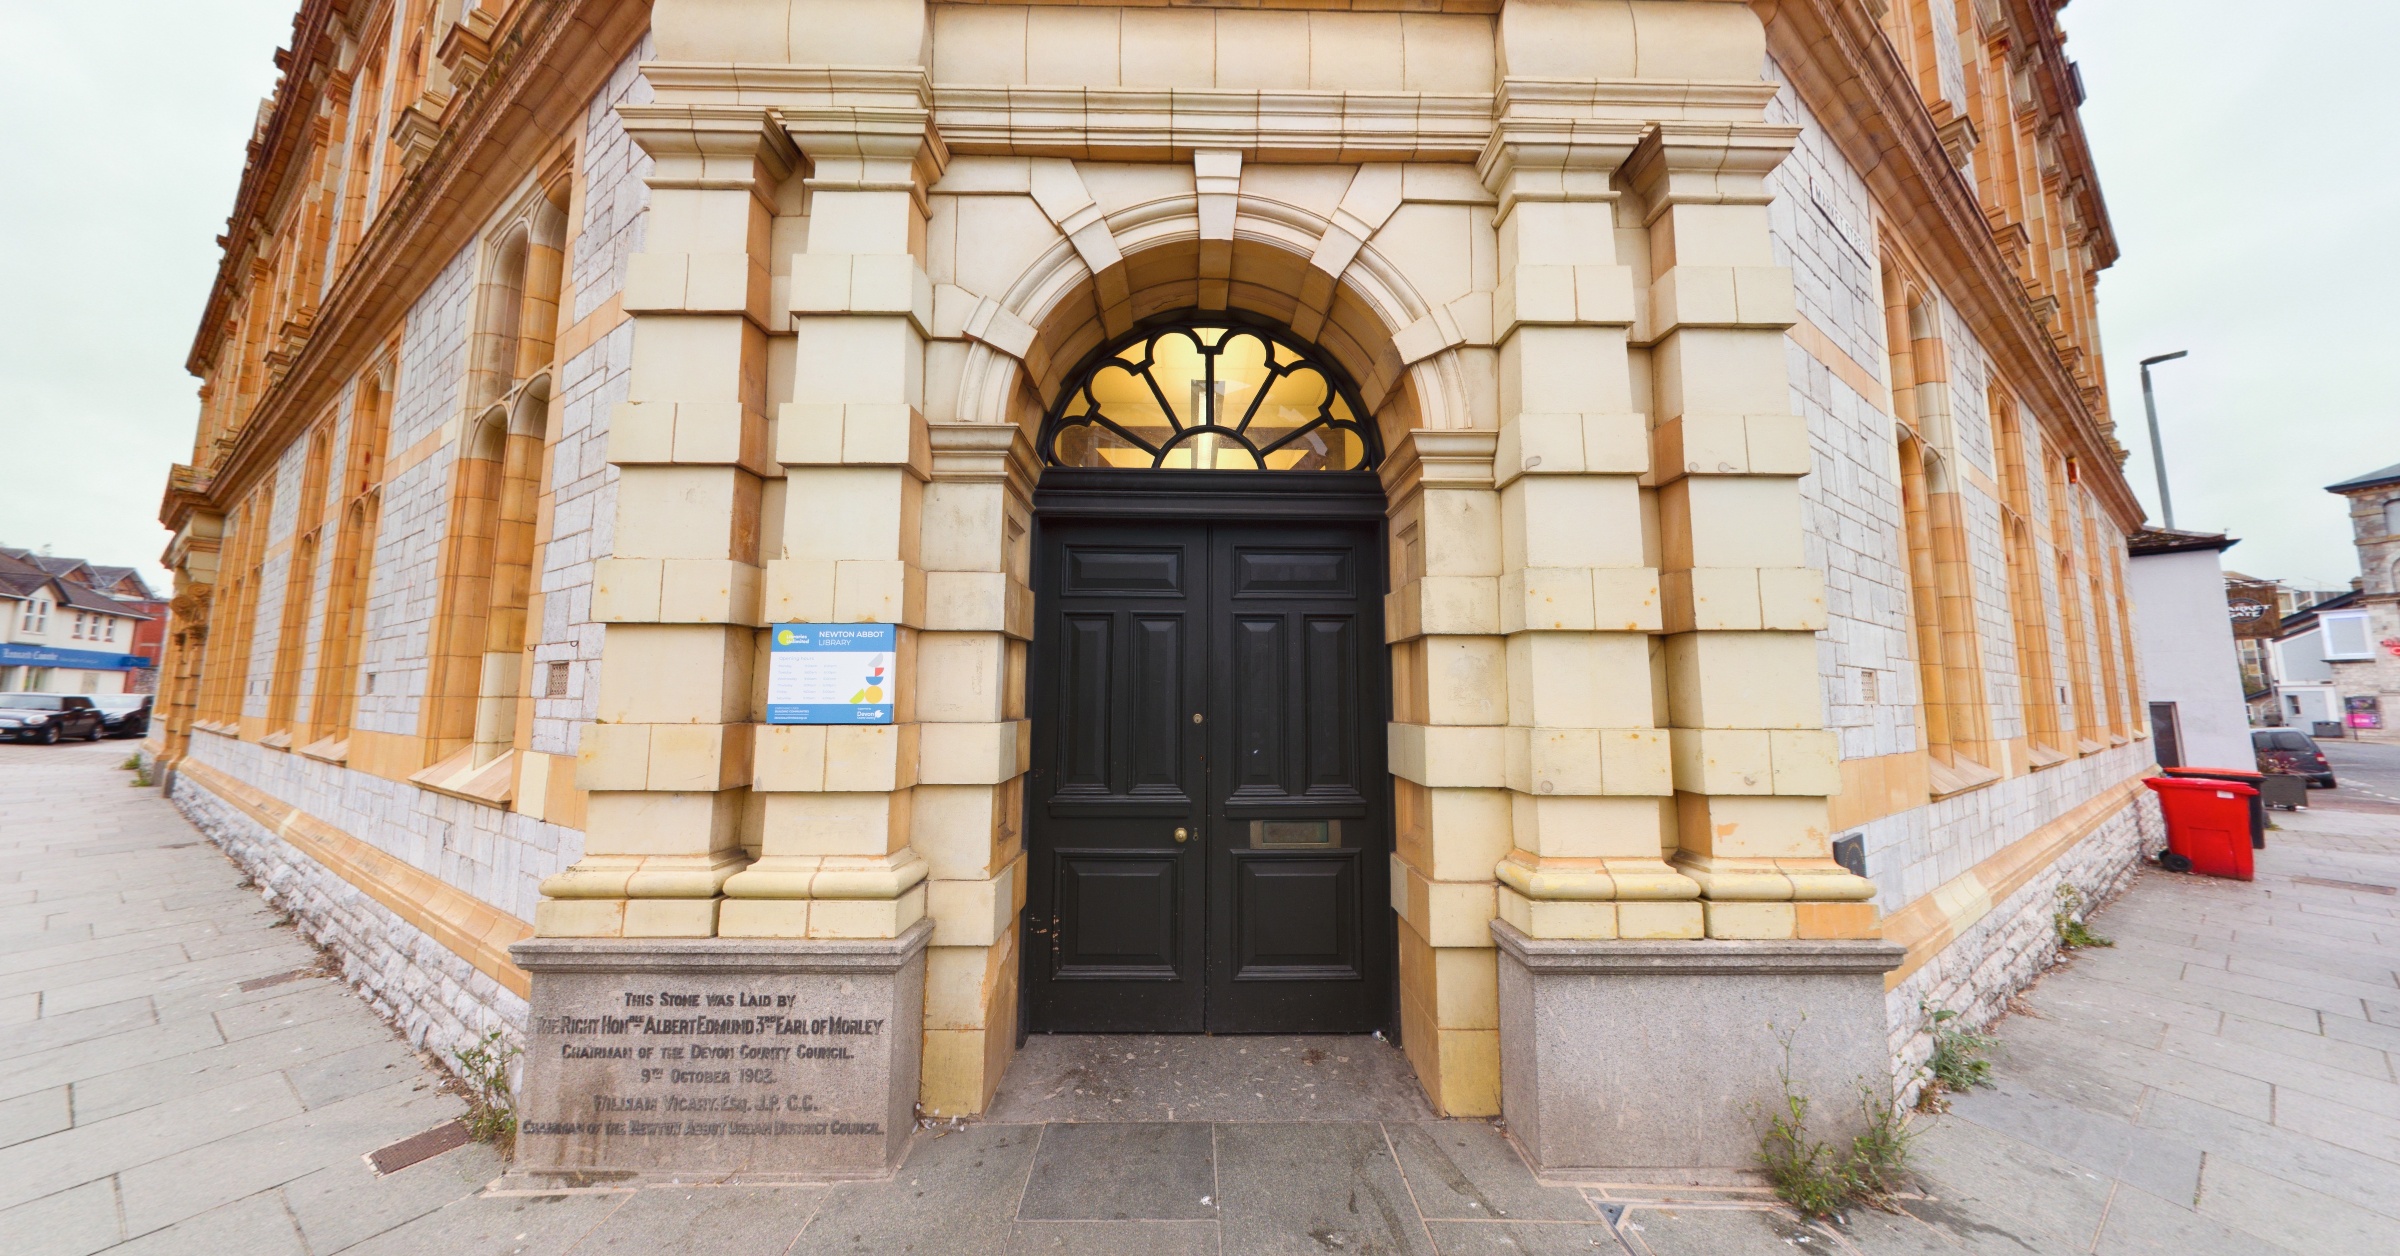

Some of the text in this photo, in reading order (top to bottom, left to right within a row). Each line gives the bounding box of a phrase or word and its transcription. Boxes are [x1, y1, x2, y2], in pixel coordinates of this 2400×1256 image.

[1815, 185, 1871, 263] MARKET STREET
[625, 992, 796, 1007] THIS STONE WAS LAID BY
[537, 1016, 560, 1035] THE
[560, 1016, 600, 1035] RIGHT
[643, 1016, 697, 1035] ALBERT
[697, 1015, 754, 1035] EDMUND
[775, 1016, 809, 1035] EARL
[811, 1018, 828, 1035] OF
[562, 1044, 855, 1060] CHAIRMAN OF THE DEVON COUNTY COUNCIL.
[670, 1069, 730, 1084] OCTOBER
[593, 1094, 657, 1112] WILLIAM
[786, 1095, 819, 1111] C.C.
[523, 1119, 884, 1136] CHAIRMAN OF THE NEWTON ABBOT URBAN DISTRICT COUNCIL.
